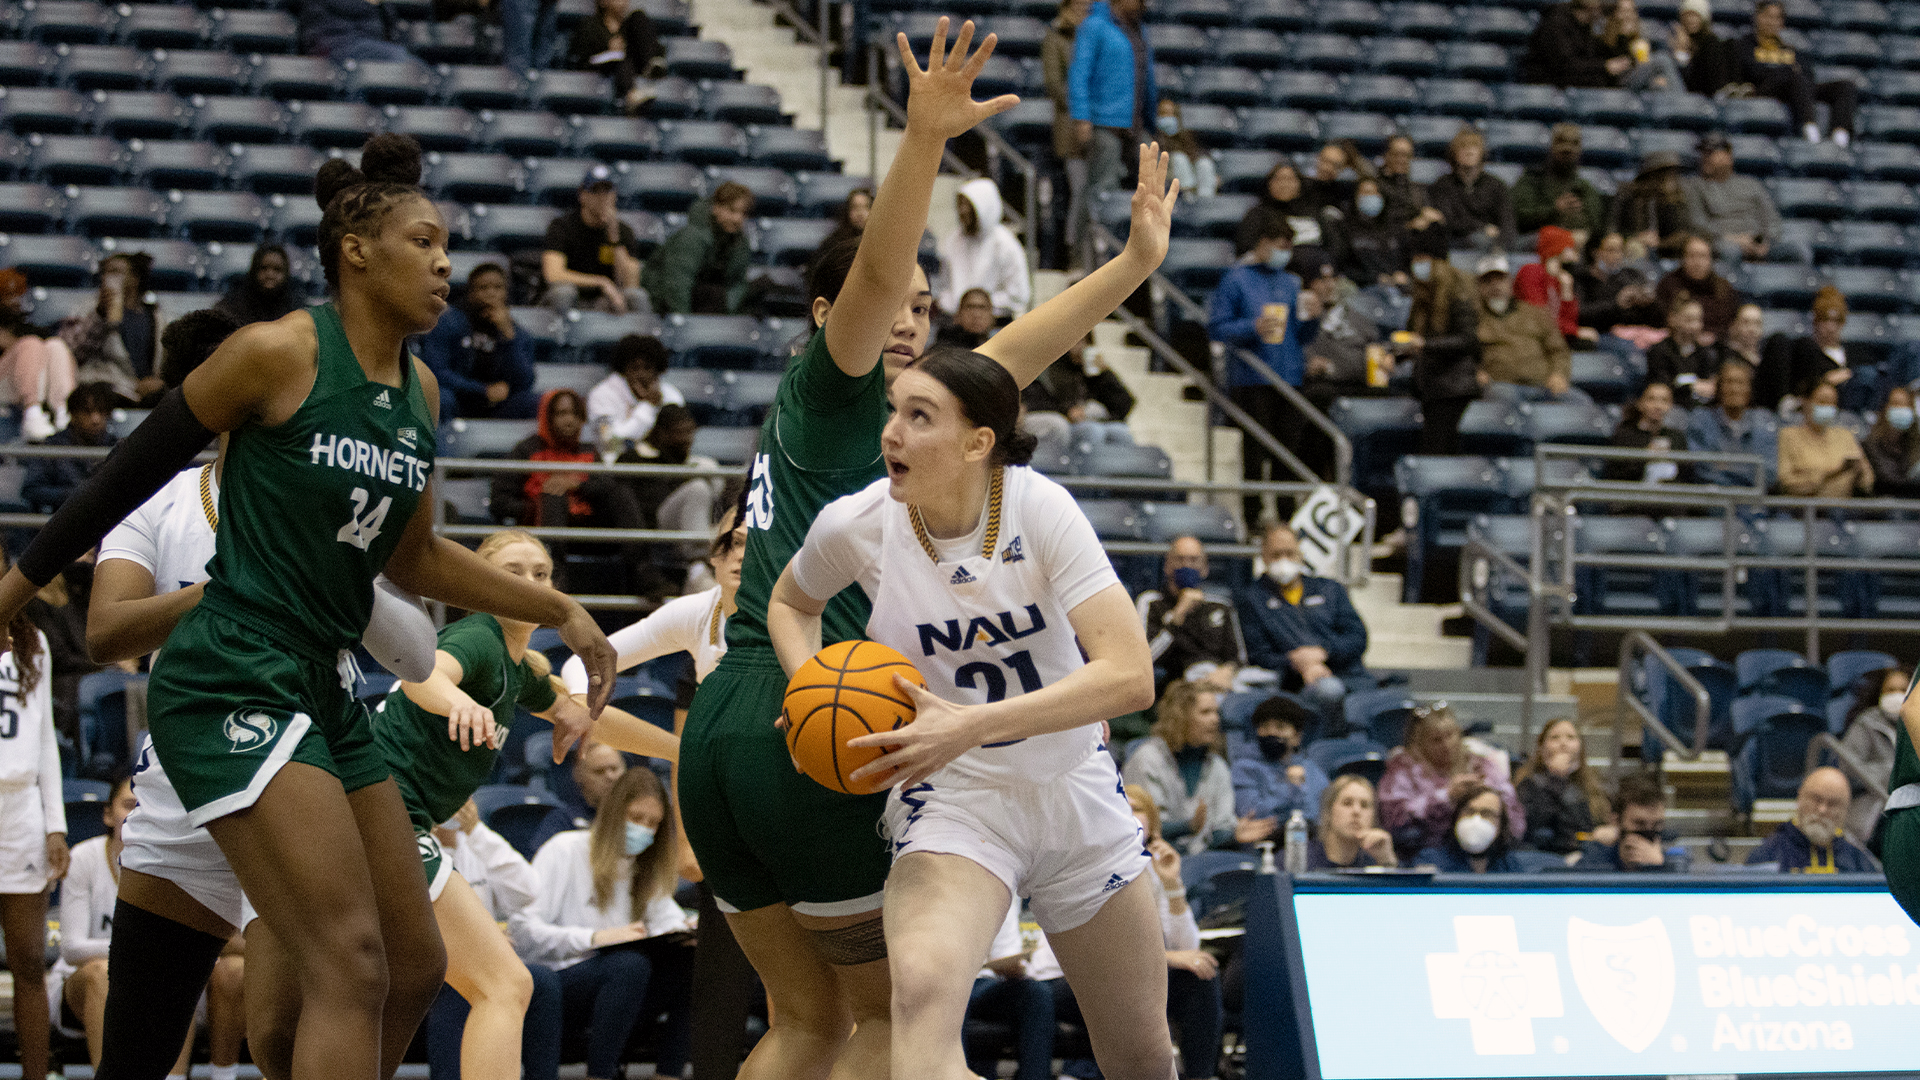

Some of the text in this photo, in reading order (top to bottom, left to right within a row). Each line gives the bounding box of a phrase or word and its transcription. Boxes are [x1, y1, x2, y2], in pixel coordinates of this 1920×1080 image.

[310, 433, 430, 492] HORNETS
[337, 487, 393, 552] 24
[951, 573, 977, 585] adidas
[915, 602, 1047, 657] NAU
[1689, 914, 1911, 958] BlueCross
[1712, 1012, 1854, 1051] Arizona
